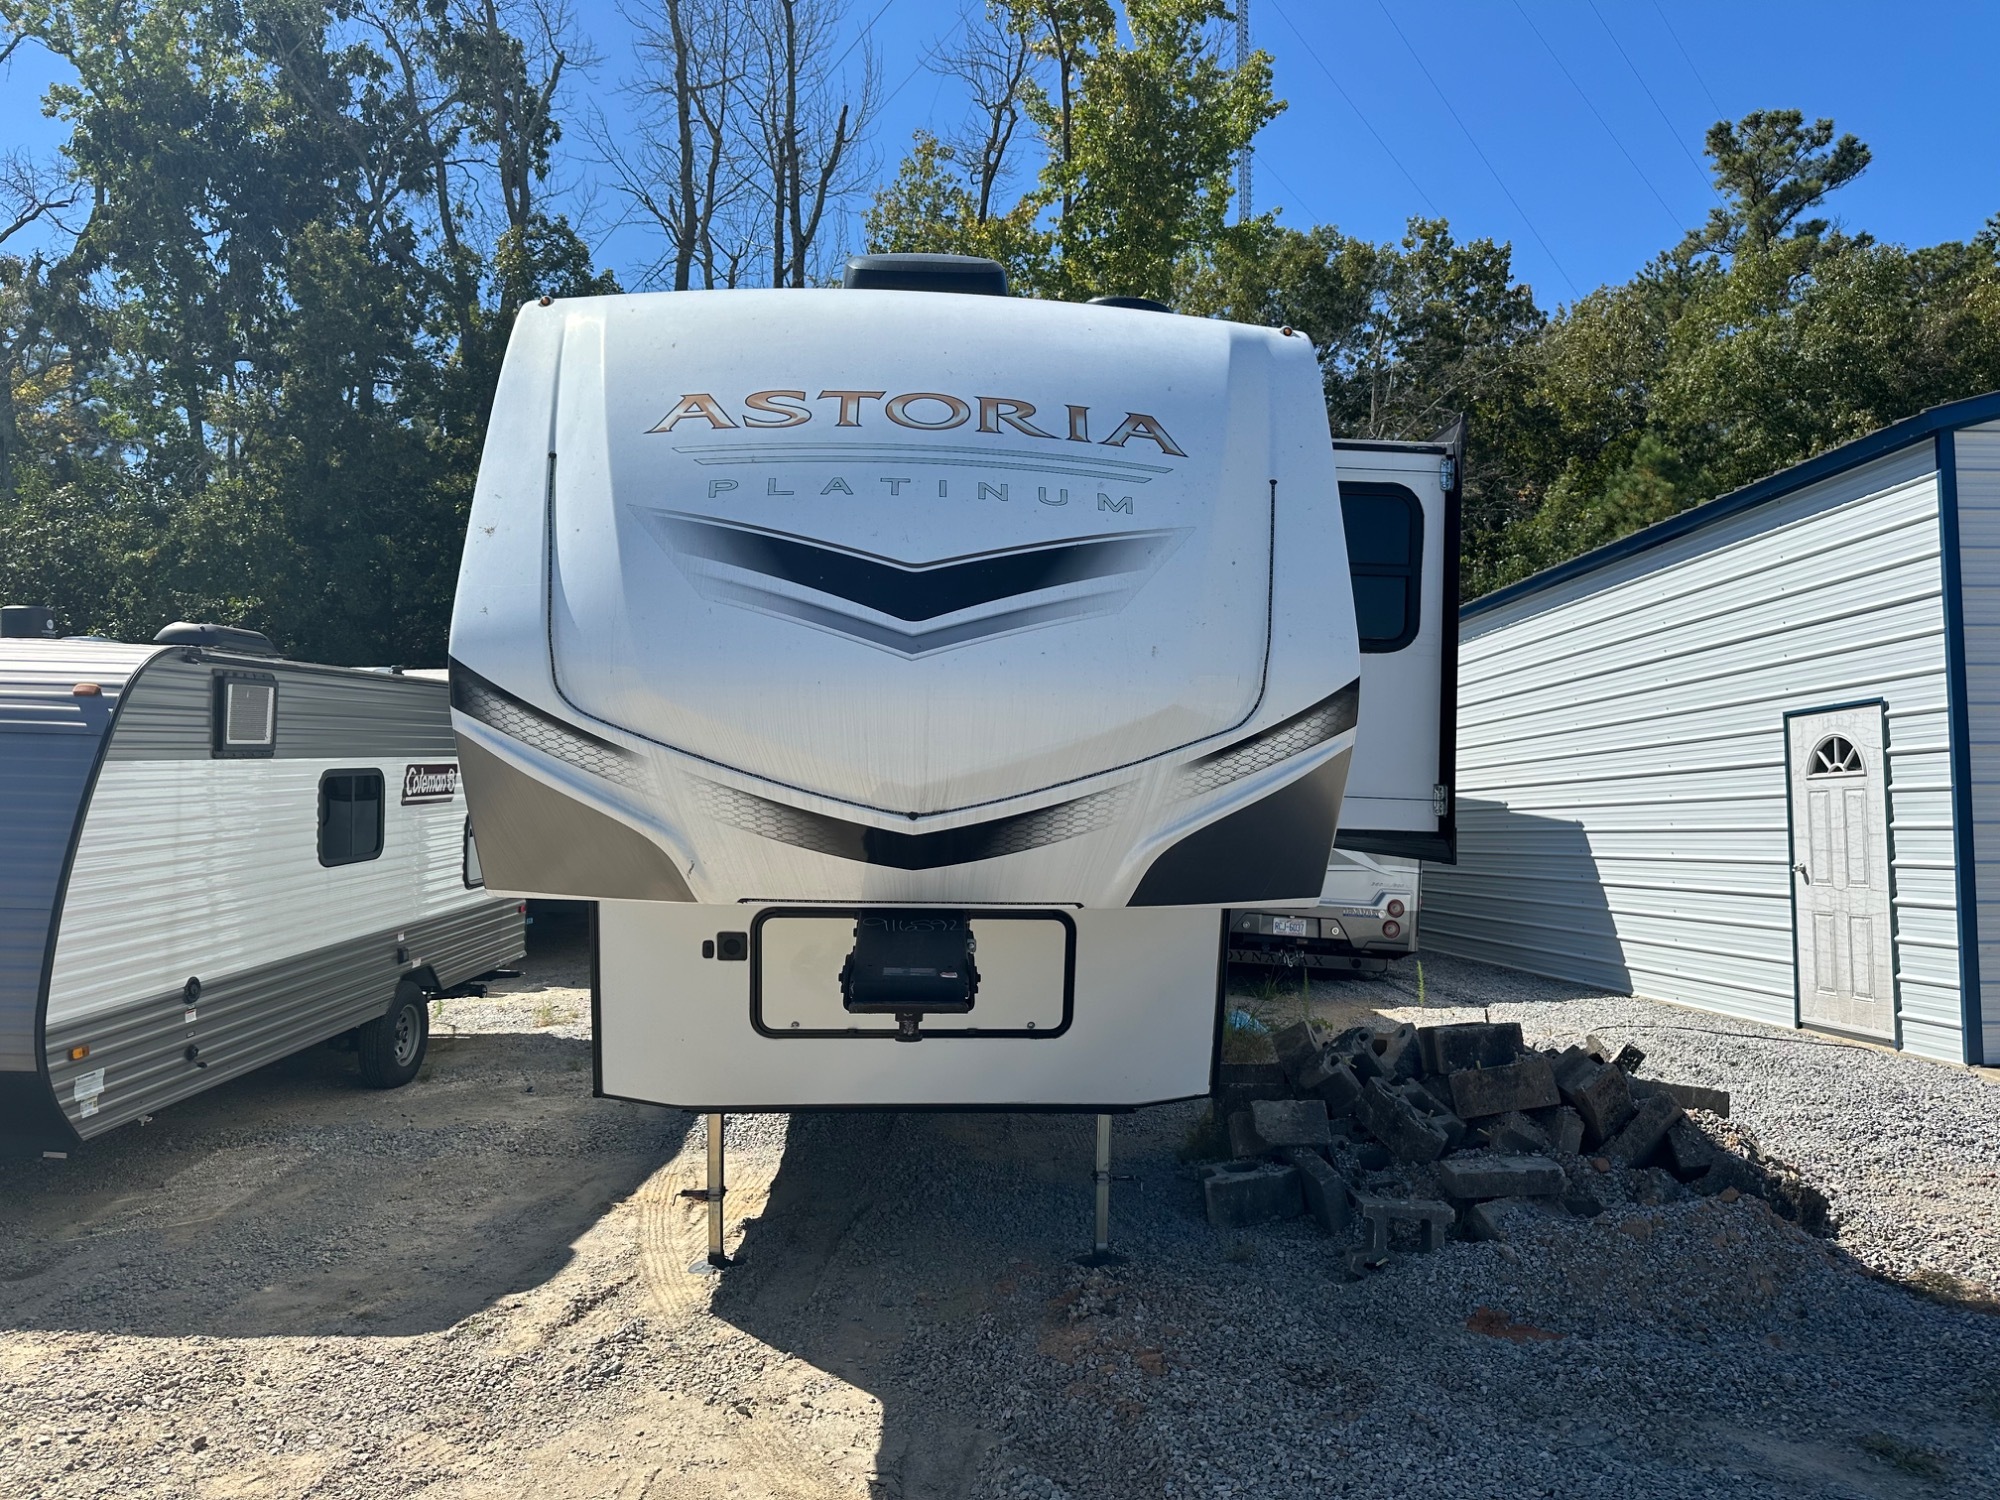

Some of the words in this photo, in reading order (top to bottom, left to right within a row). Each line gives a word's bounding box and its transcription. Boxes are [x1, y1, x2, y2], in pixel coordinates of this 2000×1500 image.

[644, 389, 1188, 458] ASTORIA
[708, 476, 1135, 515] PLATINUM
[406, 767, 447, 796] Coleman
